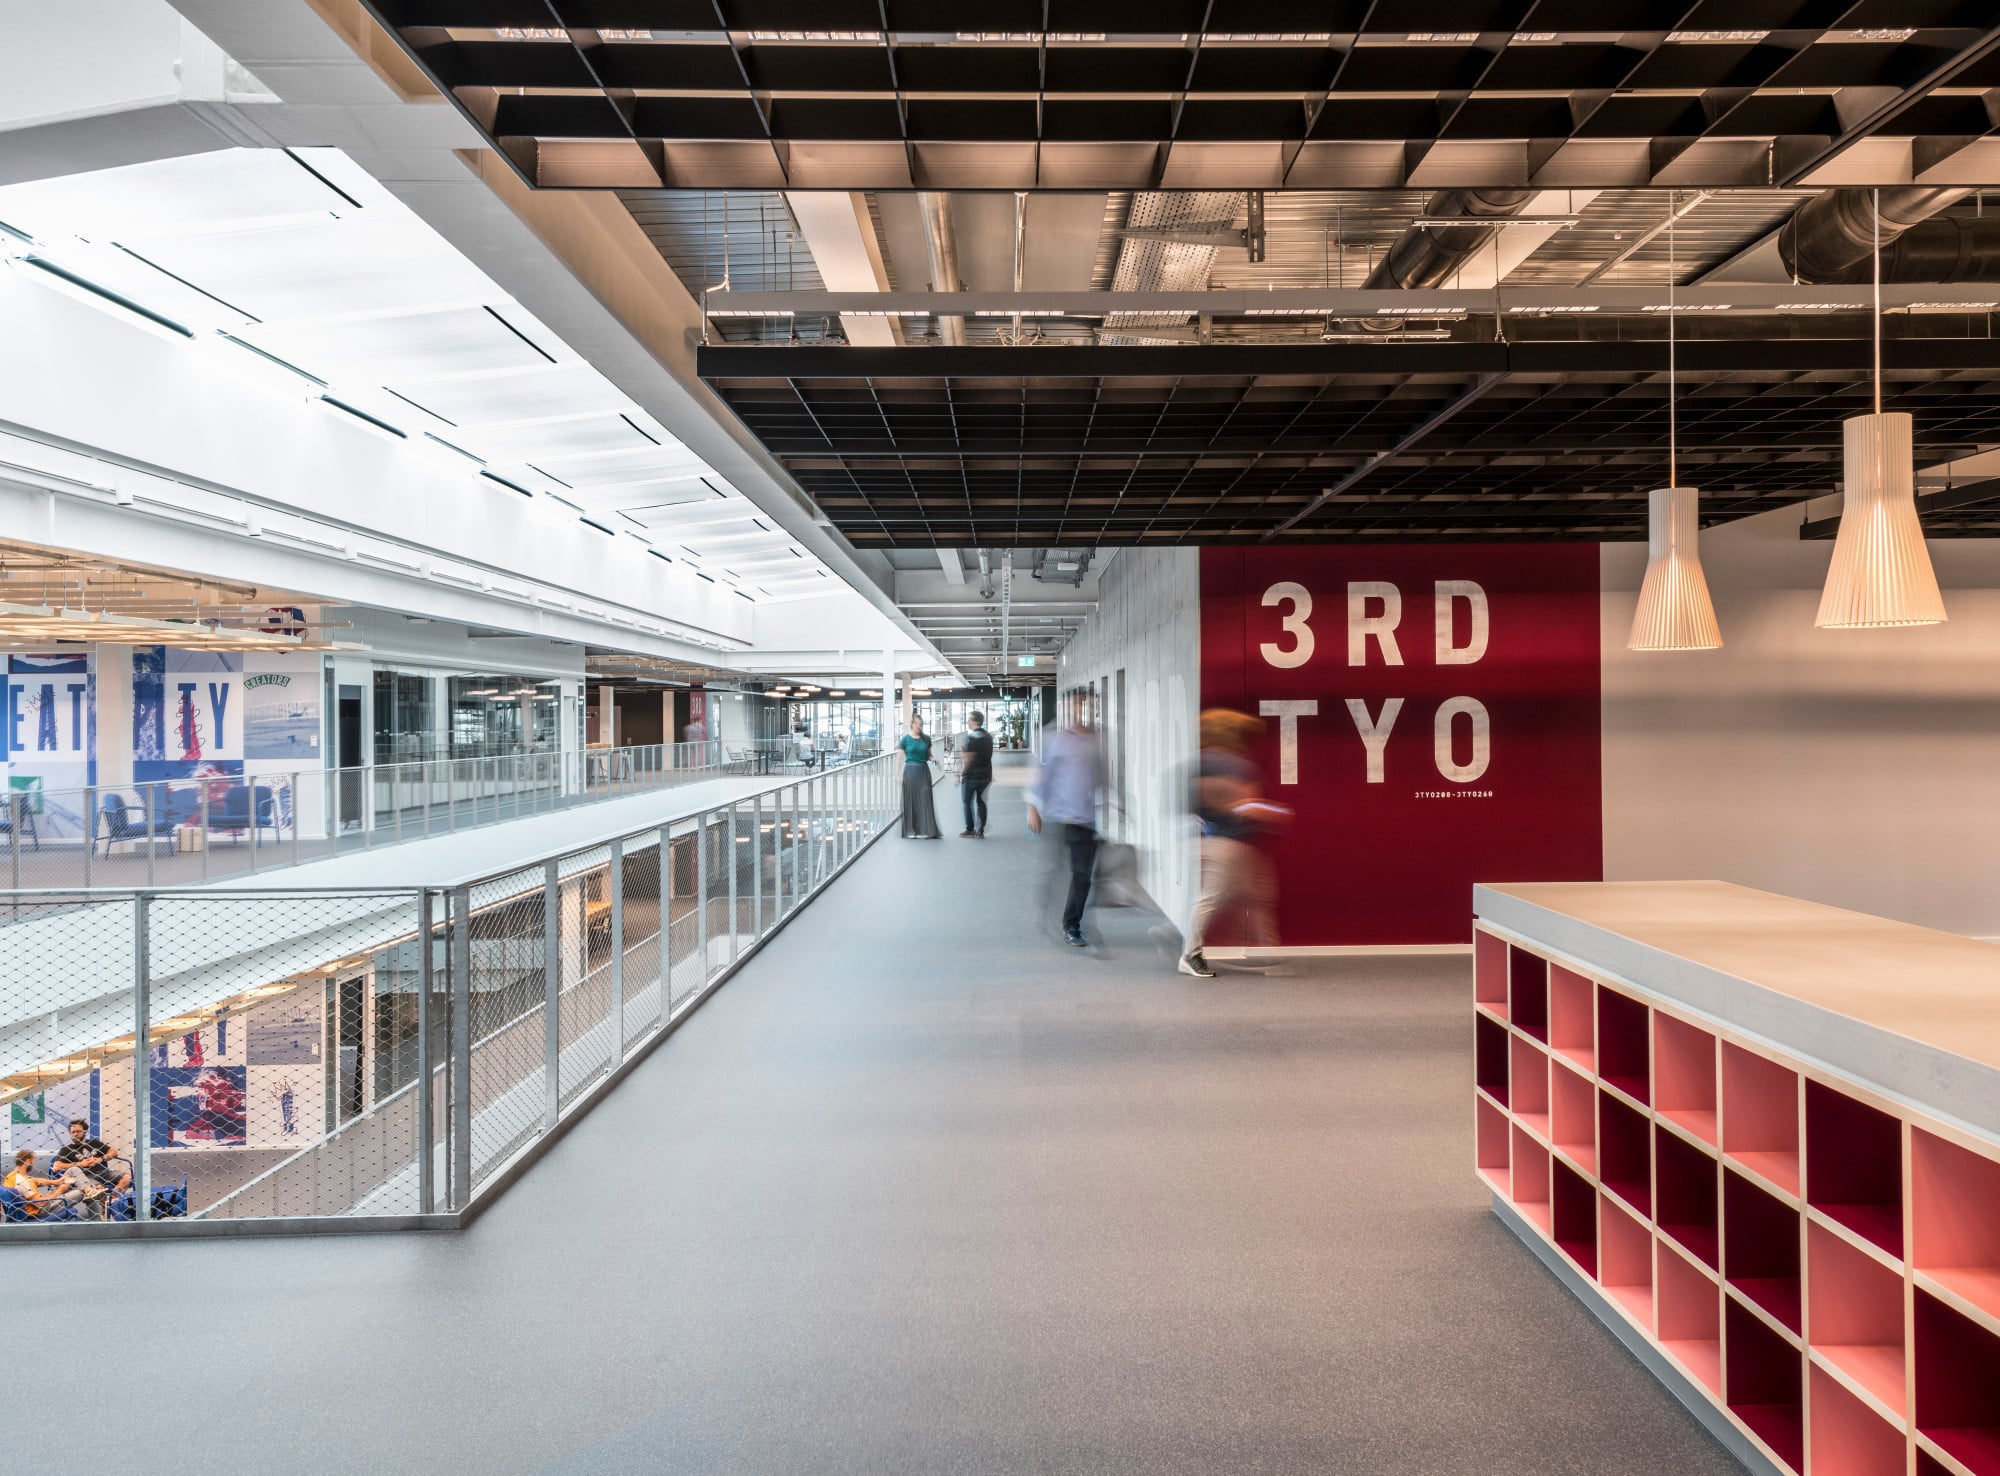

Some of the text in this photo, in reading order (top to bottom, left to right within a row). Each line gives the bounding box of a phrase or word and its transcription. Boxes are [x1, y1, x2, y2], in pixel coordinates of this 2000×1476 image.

[1259, 580, 1490, 669] 3RD
[244, 675, 289, 690] CREATORS
[1259, 695, 1490, 785] TYO
